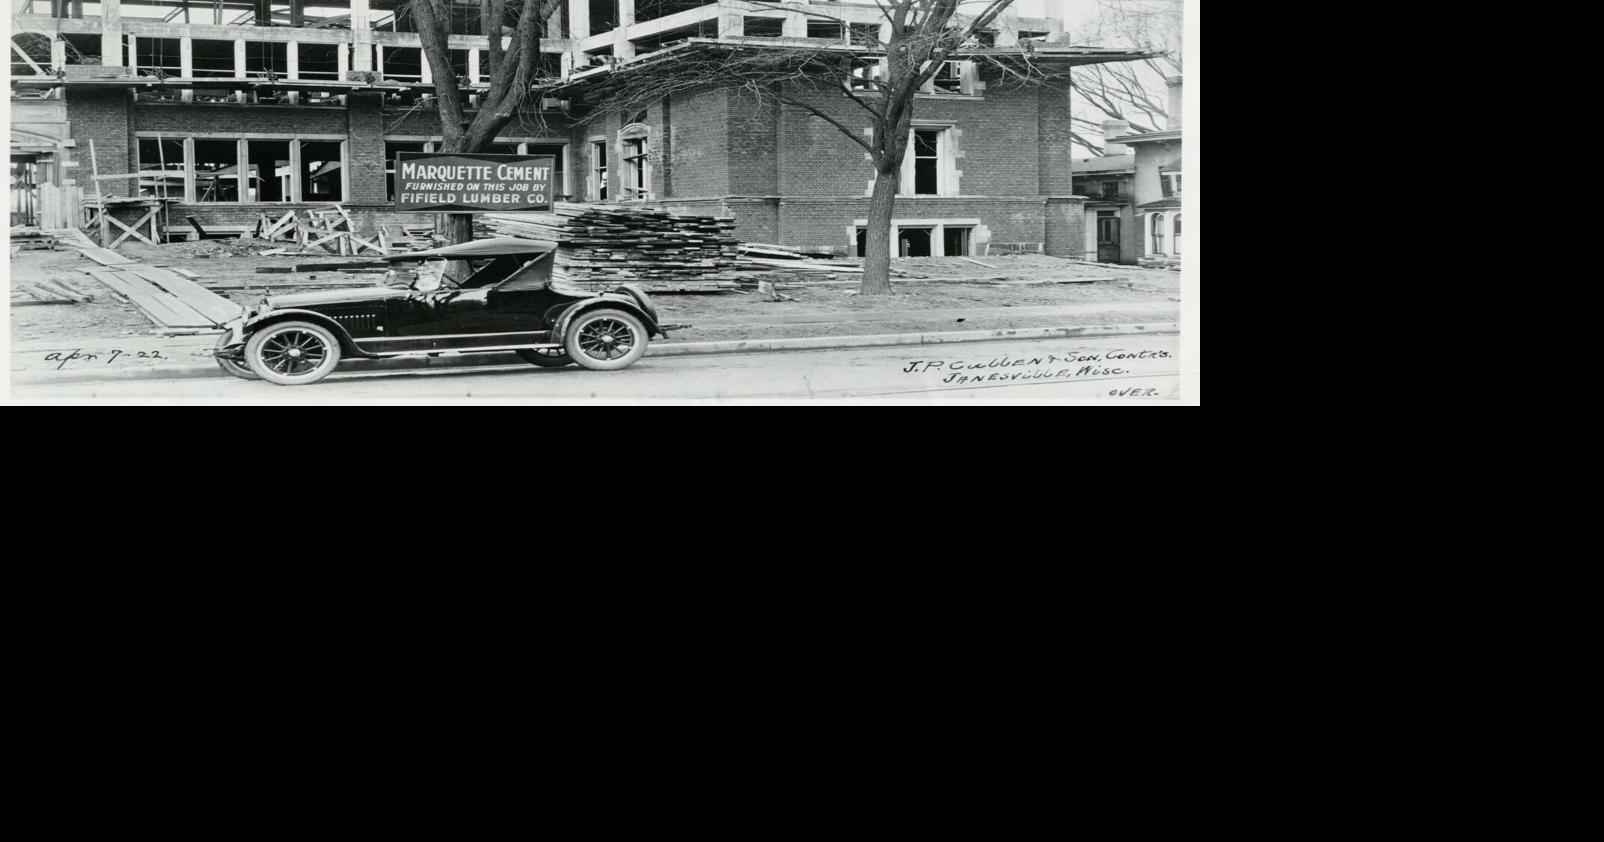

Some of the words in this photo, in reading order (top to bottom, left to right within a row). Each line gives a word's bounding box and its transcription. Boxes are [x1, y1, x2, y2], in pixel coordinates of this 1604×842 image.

[402, 163, 491, 181] MARQUETTE
[497, 164, 550, 180] CEMENT
[405, 182, 464, 191] FURNISHED
[466, 183, 480, 191] ON
[483, 183, 505, 191] THIS
[509, 183, 529, 192] JOB
[532, 183, 546, 192] BY
[401, 193, 456, 203] FIFIELD
[462, 193, 520, 204] LUMBER
[527, 193, 548, 204] CO.
